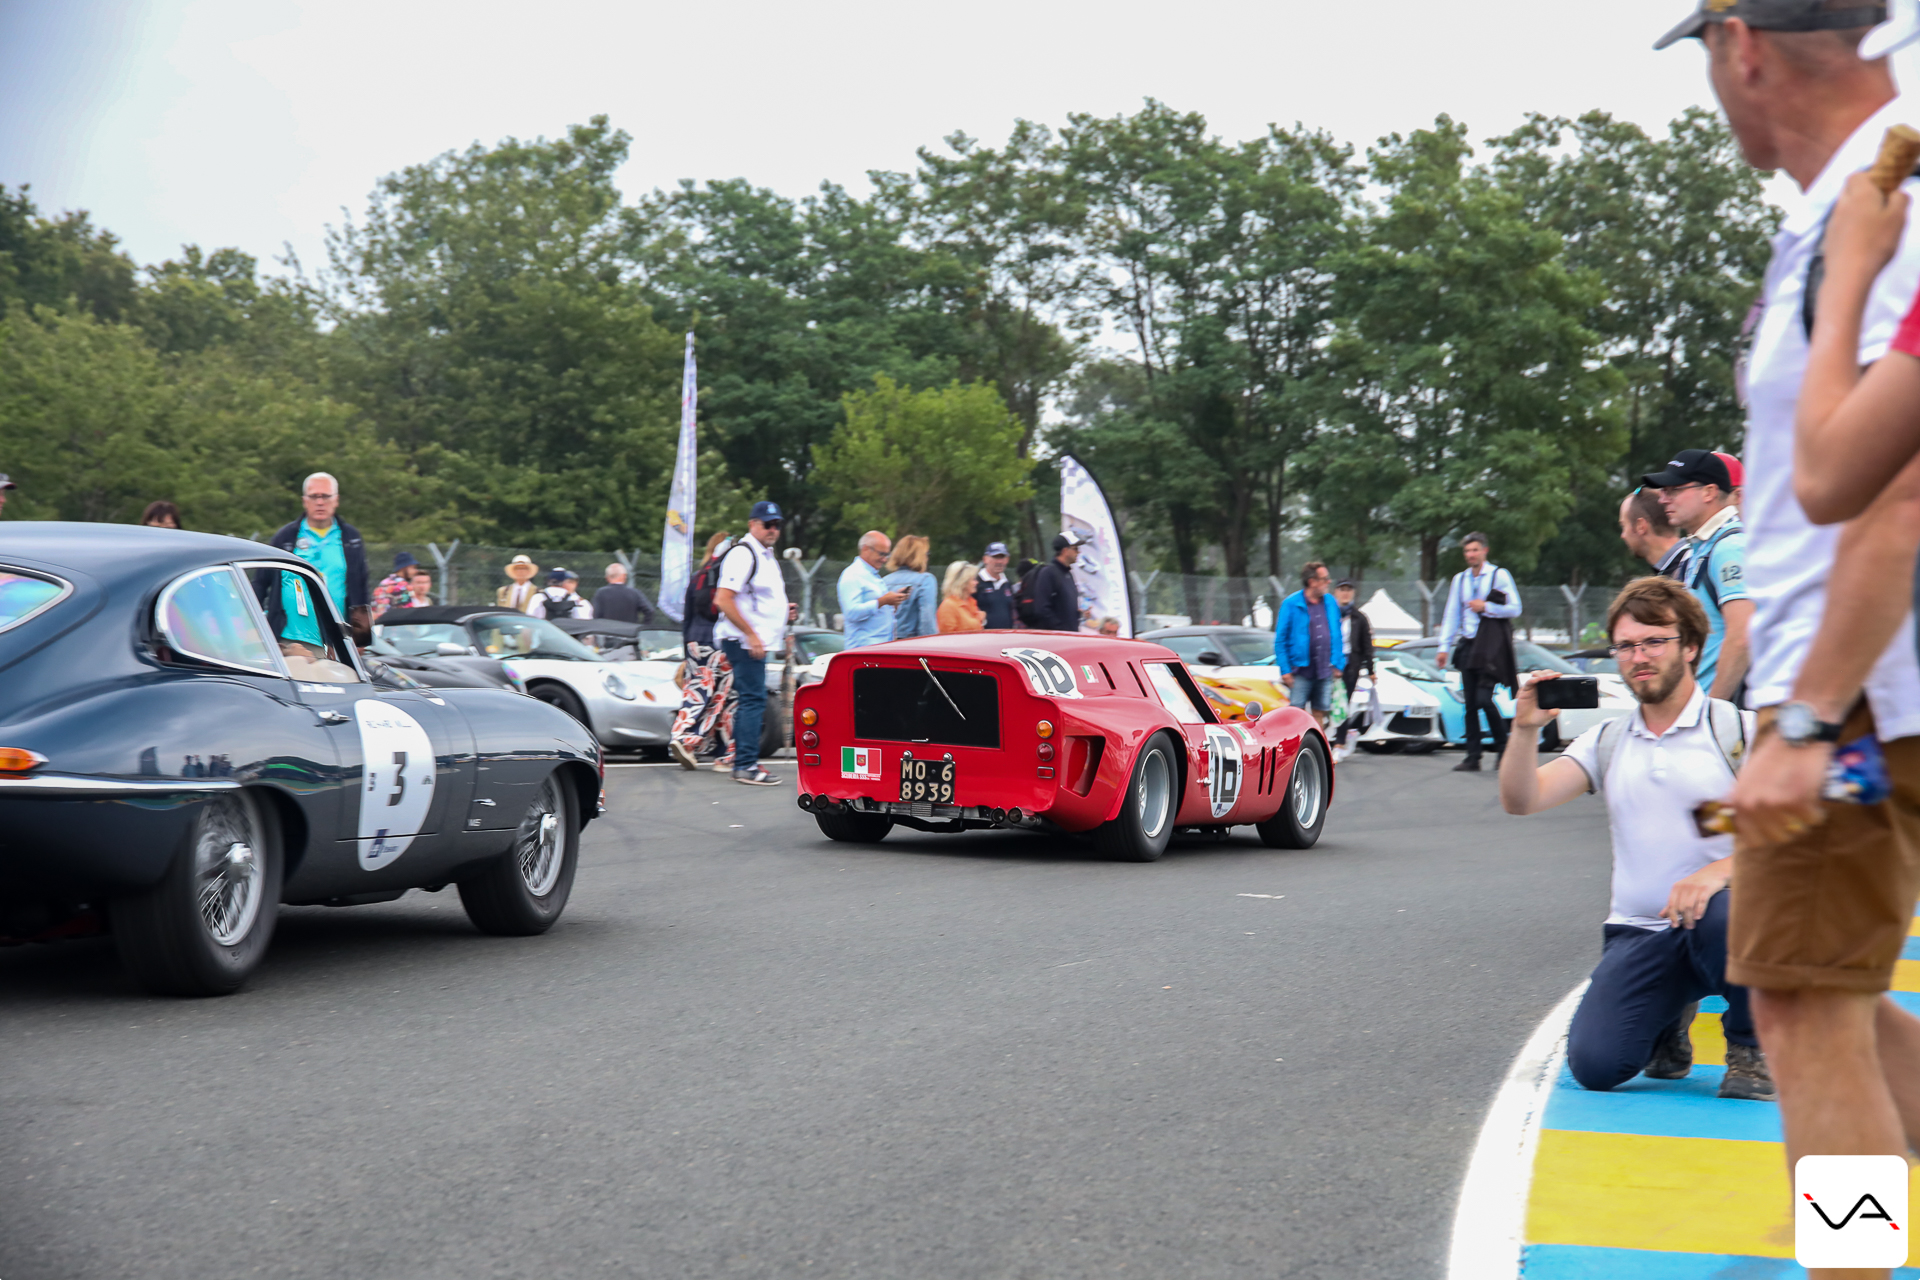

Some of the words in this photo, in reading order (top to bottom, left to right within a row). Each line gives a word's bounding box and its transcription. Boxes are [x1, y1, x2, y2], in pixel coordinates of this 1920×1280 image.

[1720, 565, 1743, 583] 12
[1014, 649, 1075, 694] 16
[387, 751, 408, 806] 3
[902, 760, 926, 780] MO
[941, 763, 953, 782] 6
[1208, 735, 1238, 803] 16
[901, 781, 952, 803] 8939
